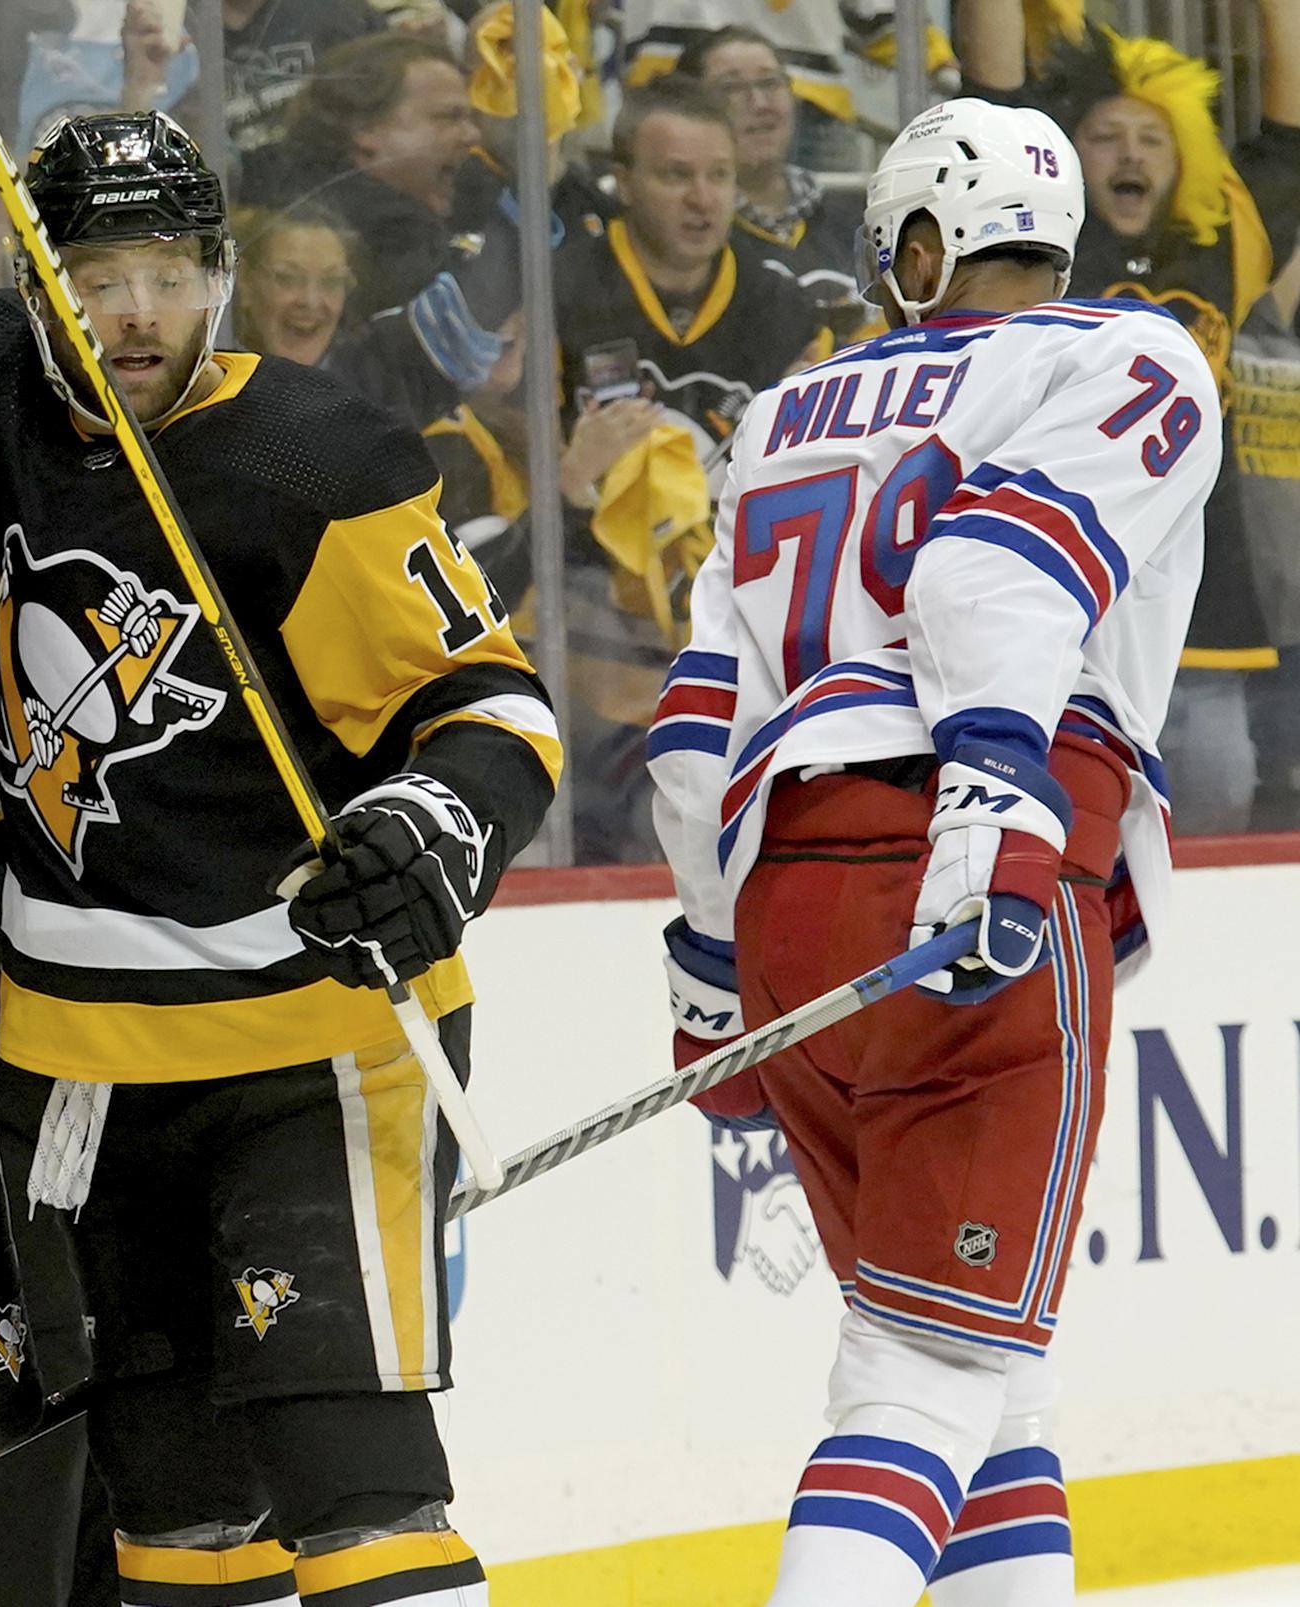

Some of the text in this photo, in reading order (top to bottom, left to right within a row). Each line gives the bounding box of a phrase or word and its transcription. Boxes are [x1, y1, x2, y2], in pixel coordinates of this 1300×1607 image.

[1024, 145, 1060, 178] 79
[91, 189, 161, 205] BAUER
[1097, 354, 1203, 478] 79
[215, 626, 249, 686] NEXUS
[983, 757, 1017, 776] MILLER
